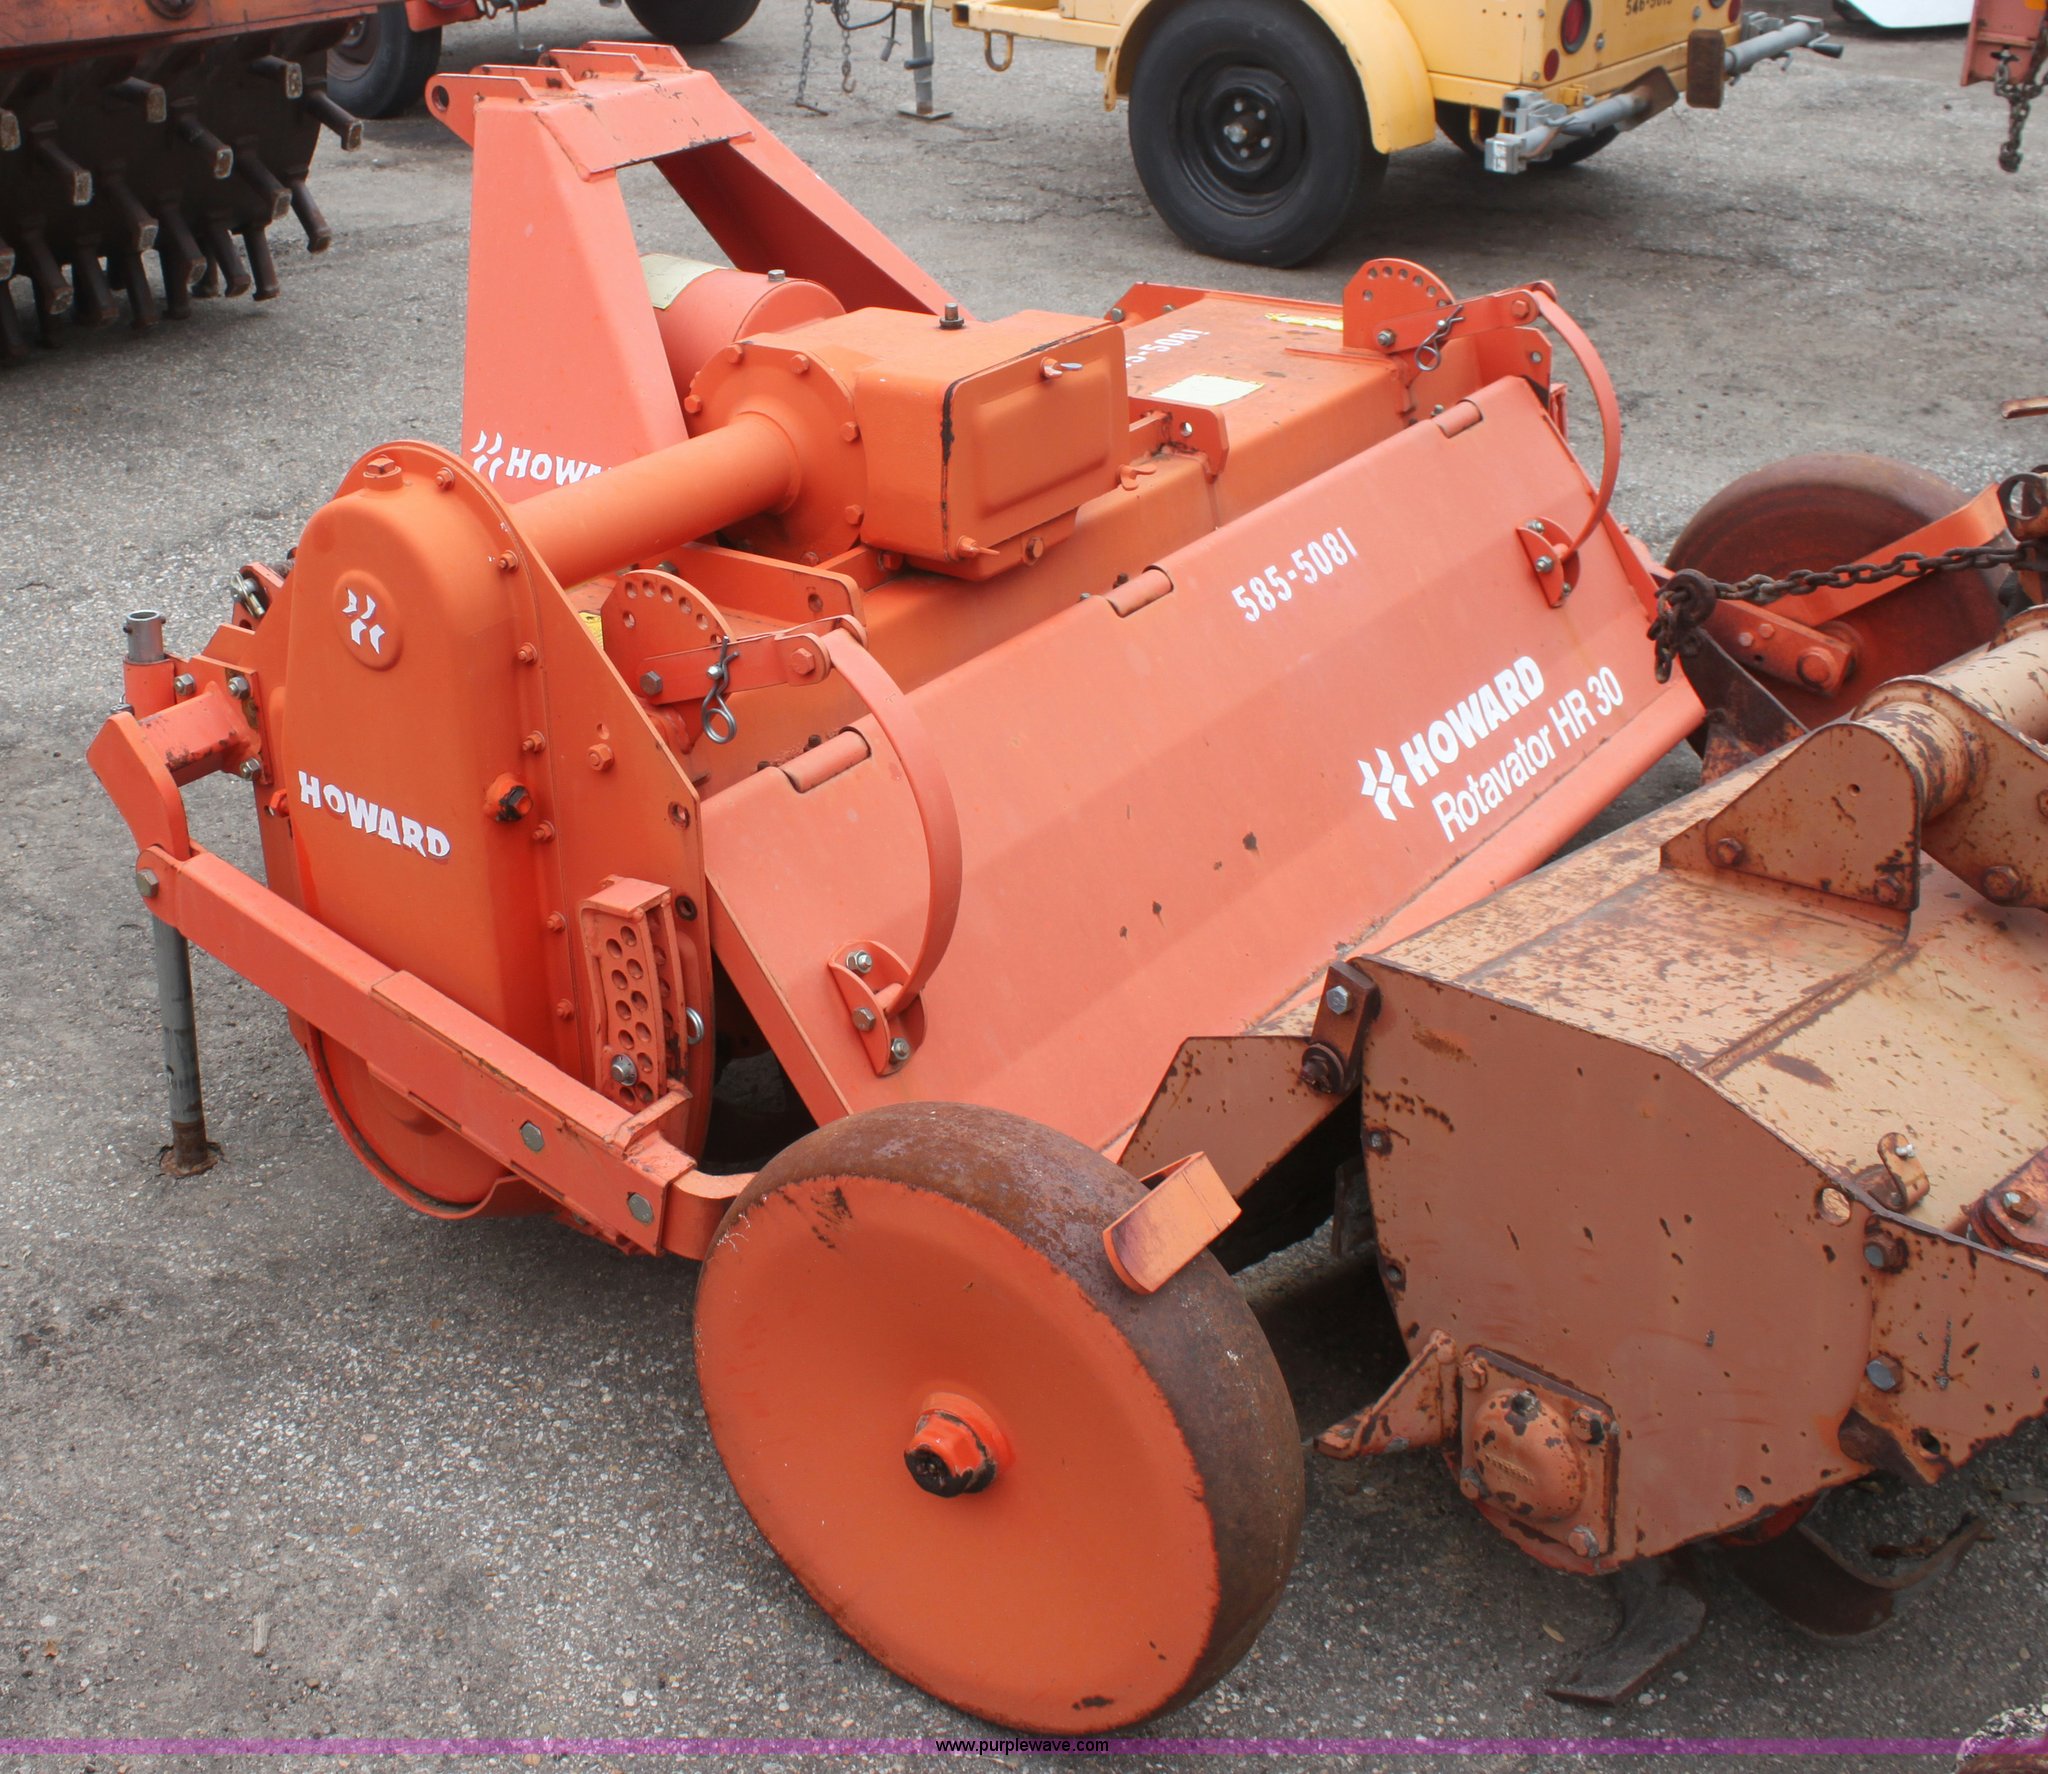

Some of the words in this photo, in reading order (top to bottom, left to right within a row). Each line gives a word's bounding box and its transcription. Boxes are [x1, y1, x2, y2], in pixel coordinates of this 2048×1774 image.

[1125, 329, 1210, 368] 5-5081
[1231, 527, 1358, 622] 585-5081
[1400, 655, 1545, 787] HOWARD
[1431, 724, 1557, 843] Rotavator
[1548, 688, 1597, 748] HR
[1586, 666, 1624, 716] 30
[298, 770, 451, 858] HOWARD
